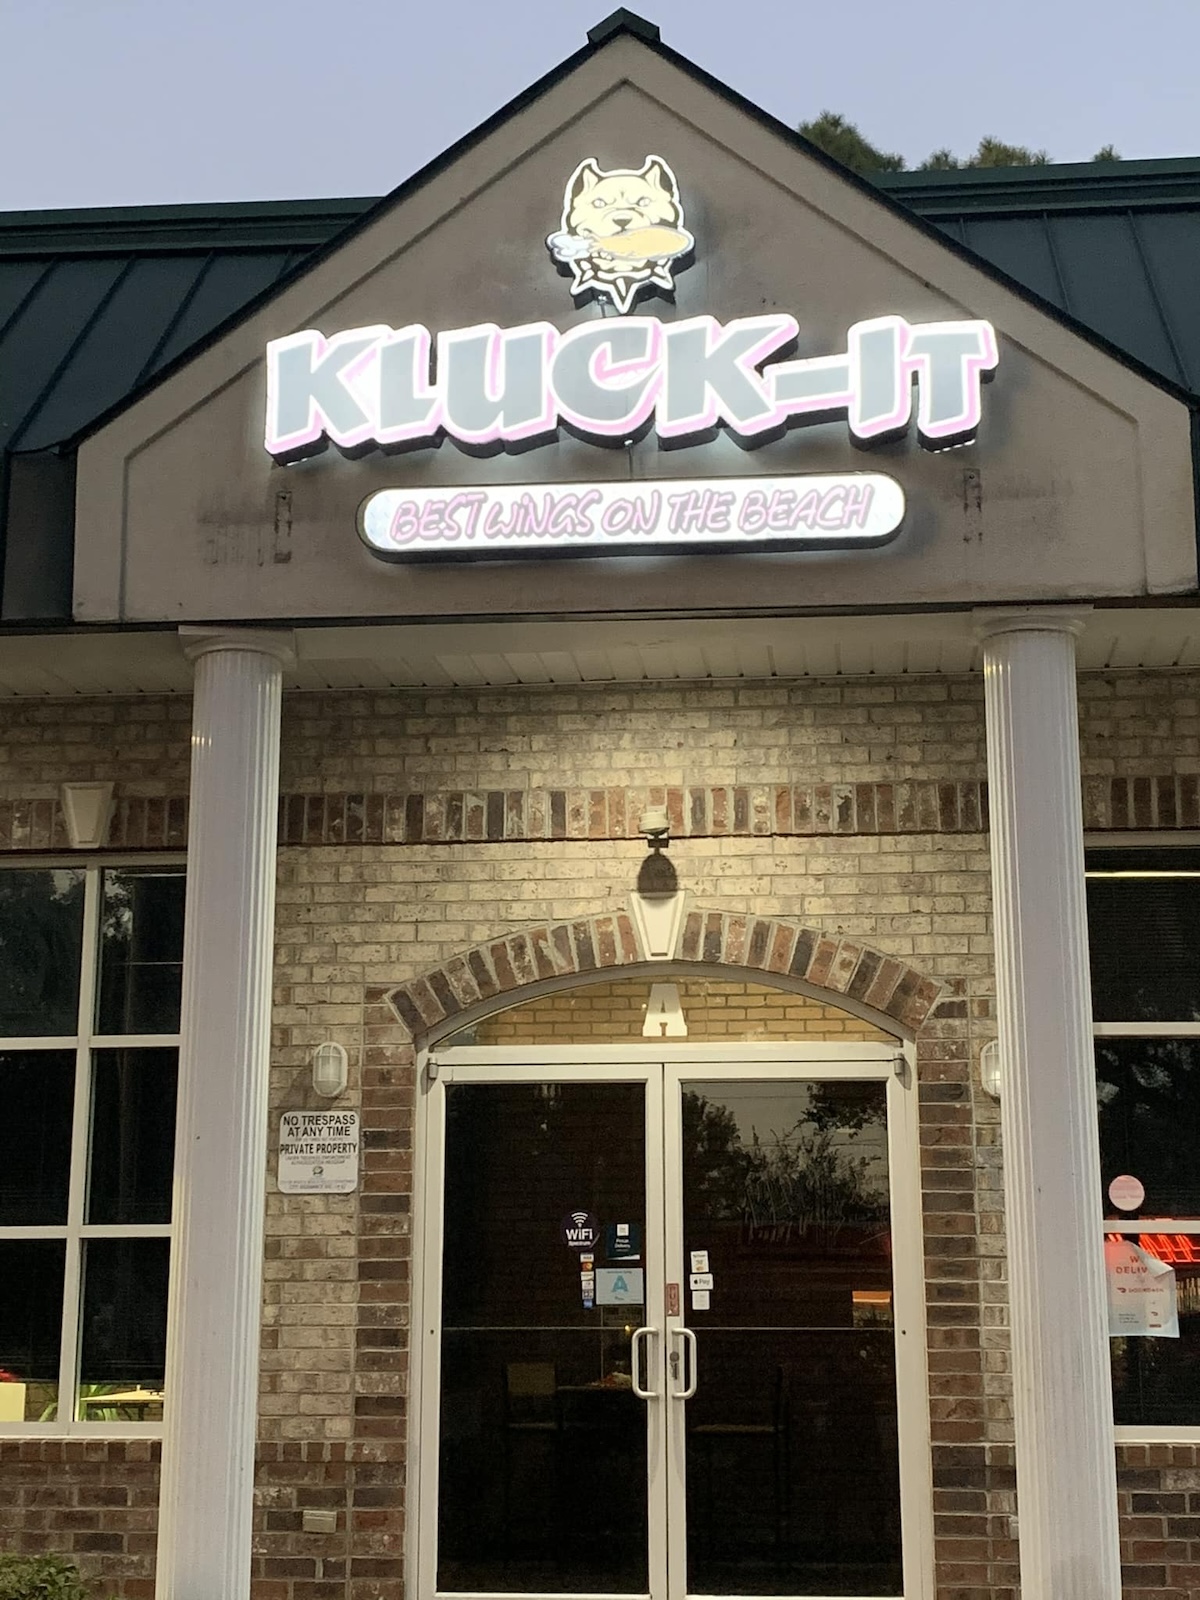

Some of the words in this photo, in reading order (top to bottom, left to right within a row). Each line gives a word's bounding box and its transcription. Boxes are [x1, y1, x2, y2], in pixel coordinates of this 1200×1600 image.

[265, 314, 999, 456] KLUCK-IT
[390, 491, 488, 544] BEST
[602, 489, 662, 537] ON
[668, 488, 736, 534] THE
[738, 483, 875, 535] BEACH
[283, 1116, 299, 1126] NO
[301, 1115, 355, 1126] TRESPASS
[287, 1127, 301, 1137] AT
[301, 1126, 324, 1137] ANY
[326, 1126, 351, 1136] TIME
[280, 1143, 314, 1155] PRIVATE
[315, 1142, 358, 1154] PROPERTY
[611, 1275, 629, 1293] A
